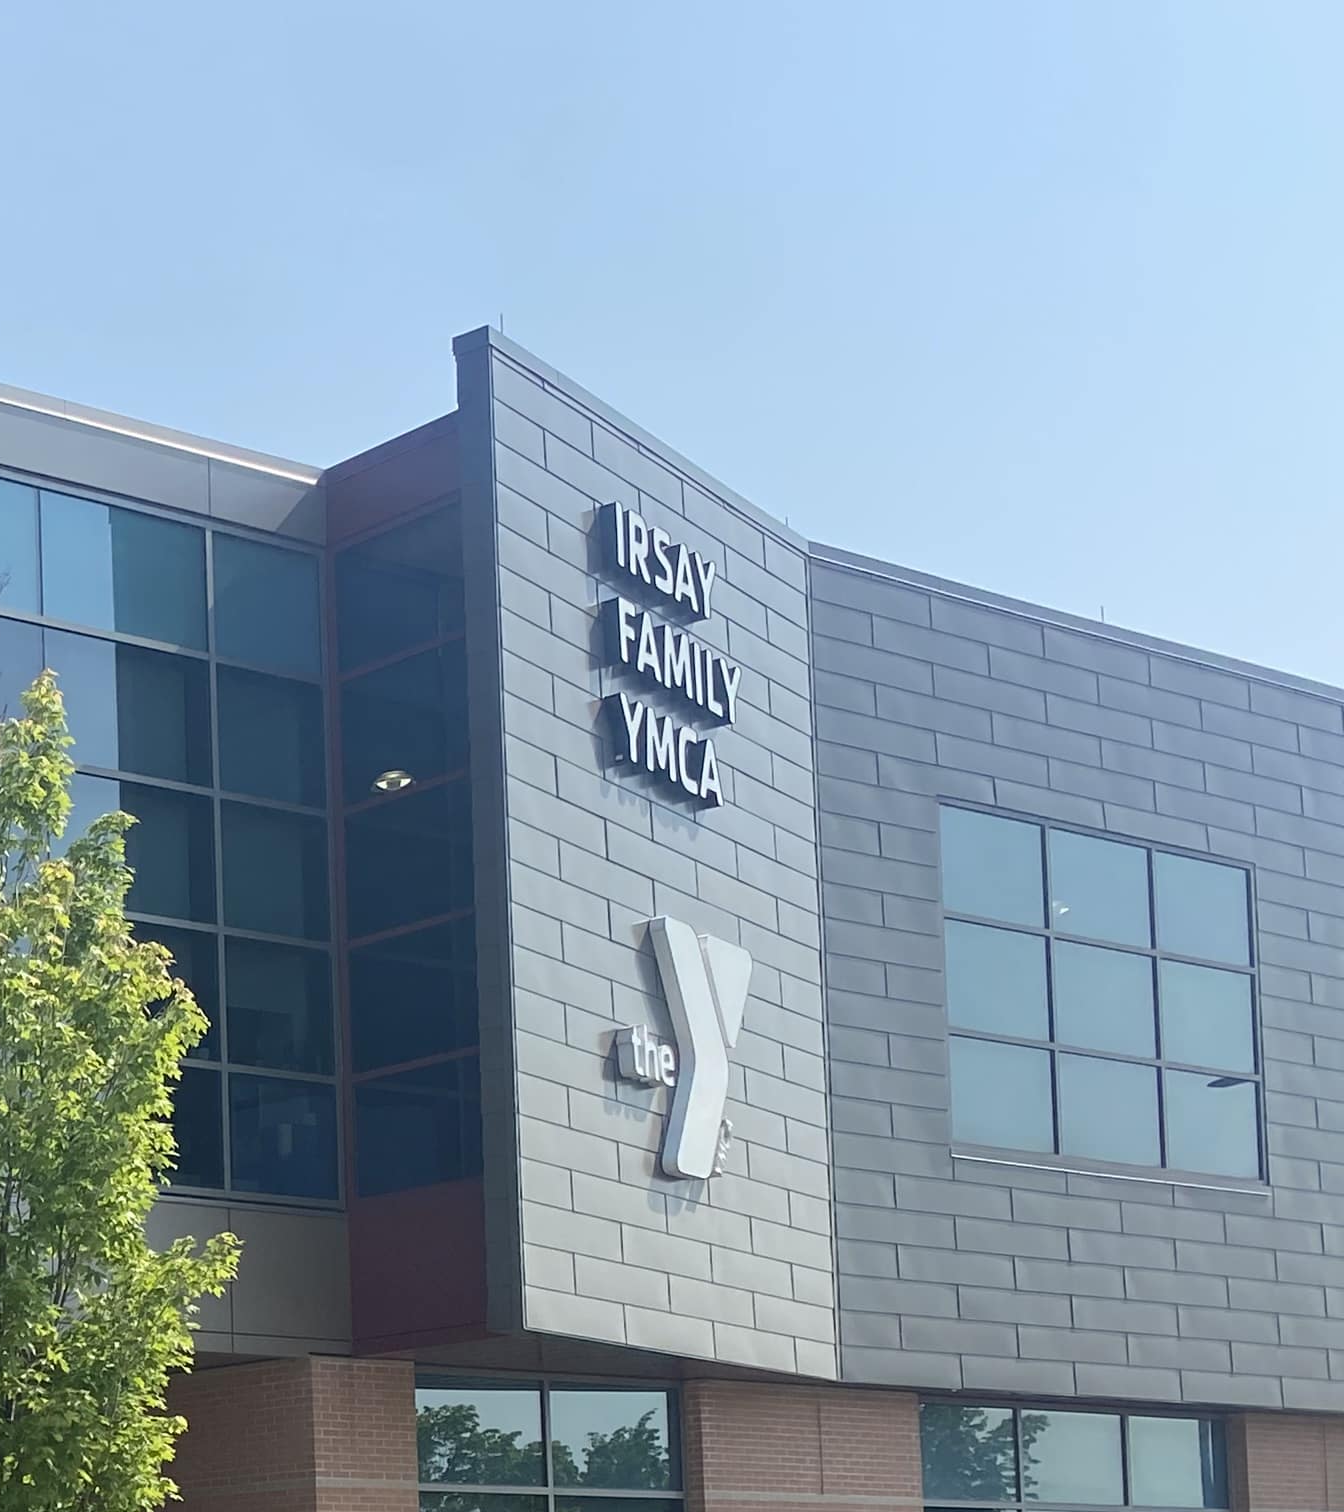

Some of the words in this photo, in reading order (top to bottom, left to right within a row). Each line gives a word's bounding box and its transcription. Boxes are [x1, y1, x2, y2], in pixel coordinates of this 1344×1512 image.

[615, 501, 716, 619] IRSAY
[617, 597, 742, 724] FAMILY
[620, 692, 724, 807] YMCA
[632, 1024, 676, 1087] the
[649, 916, 752, 1179] Y
